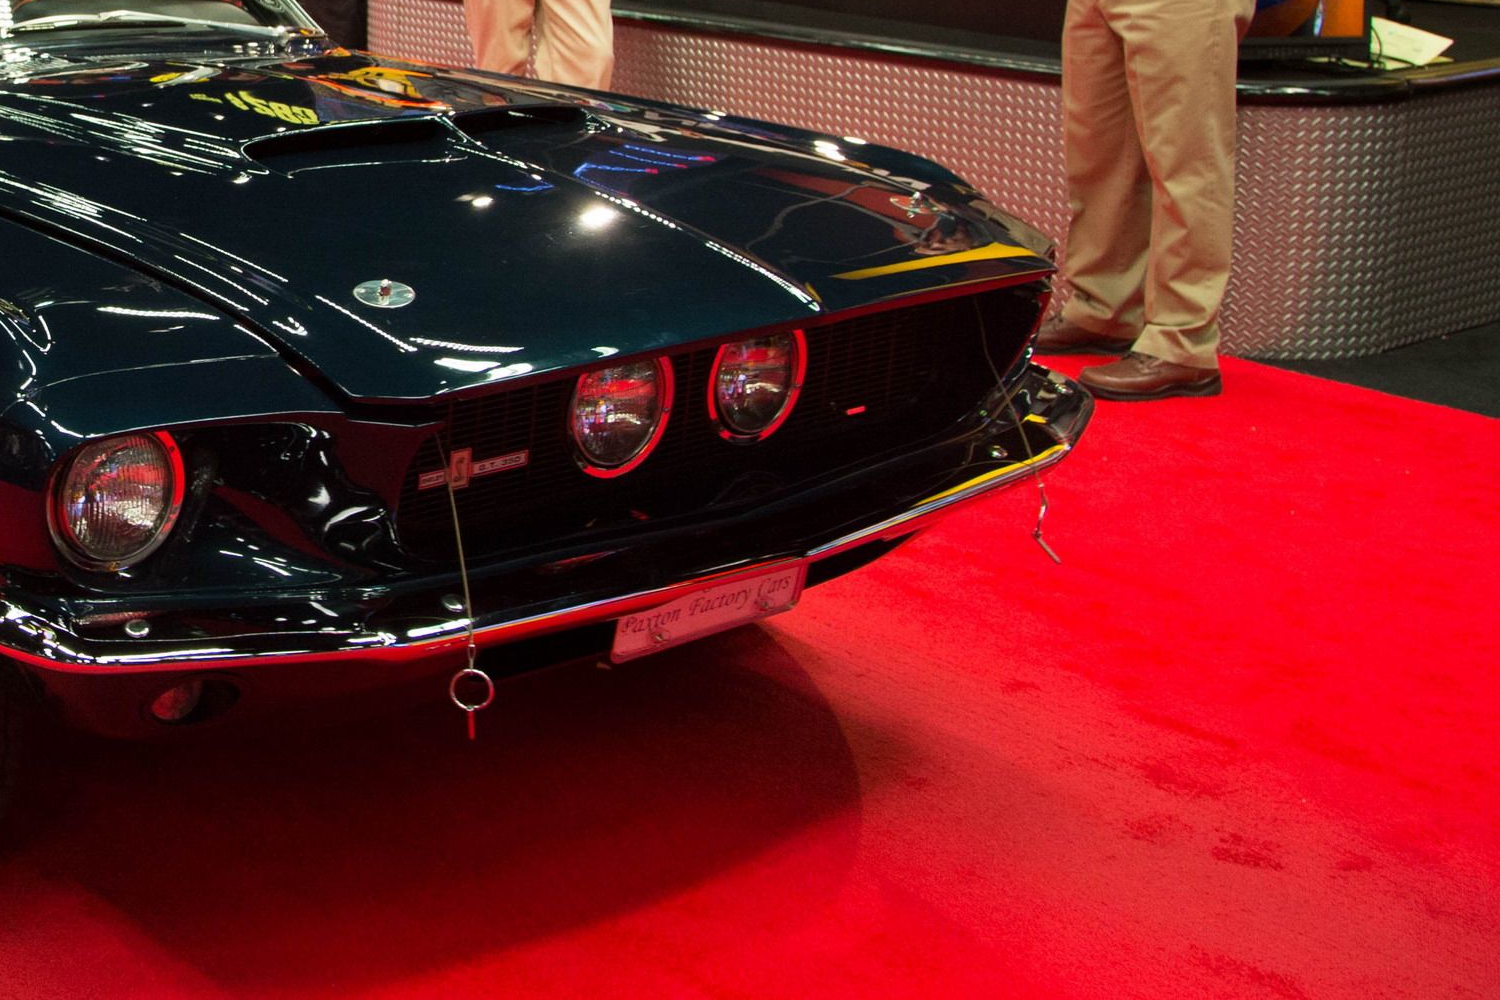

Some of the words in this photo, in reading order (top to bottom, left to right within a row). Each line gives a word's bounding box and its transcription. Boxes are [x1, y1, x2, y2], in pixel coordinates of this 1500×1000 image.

[621, 607, 682, 634] Paxton
[688, 588, 751, 617] Factory
[756, 574, 791, 602] Cars
